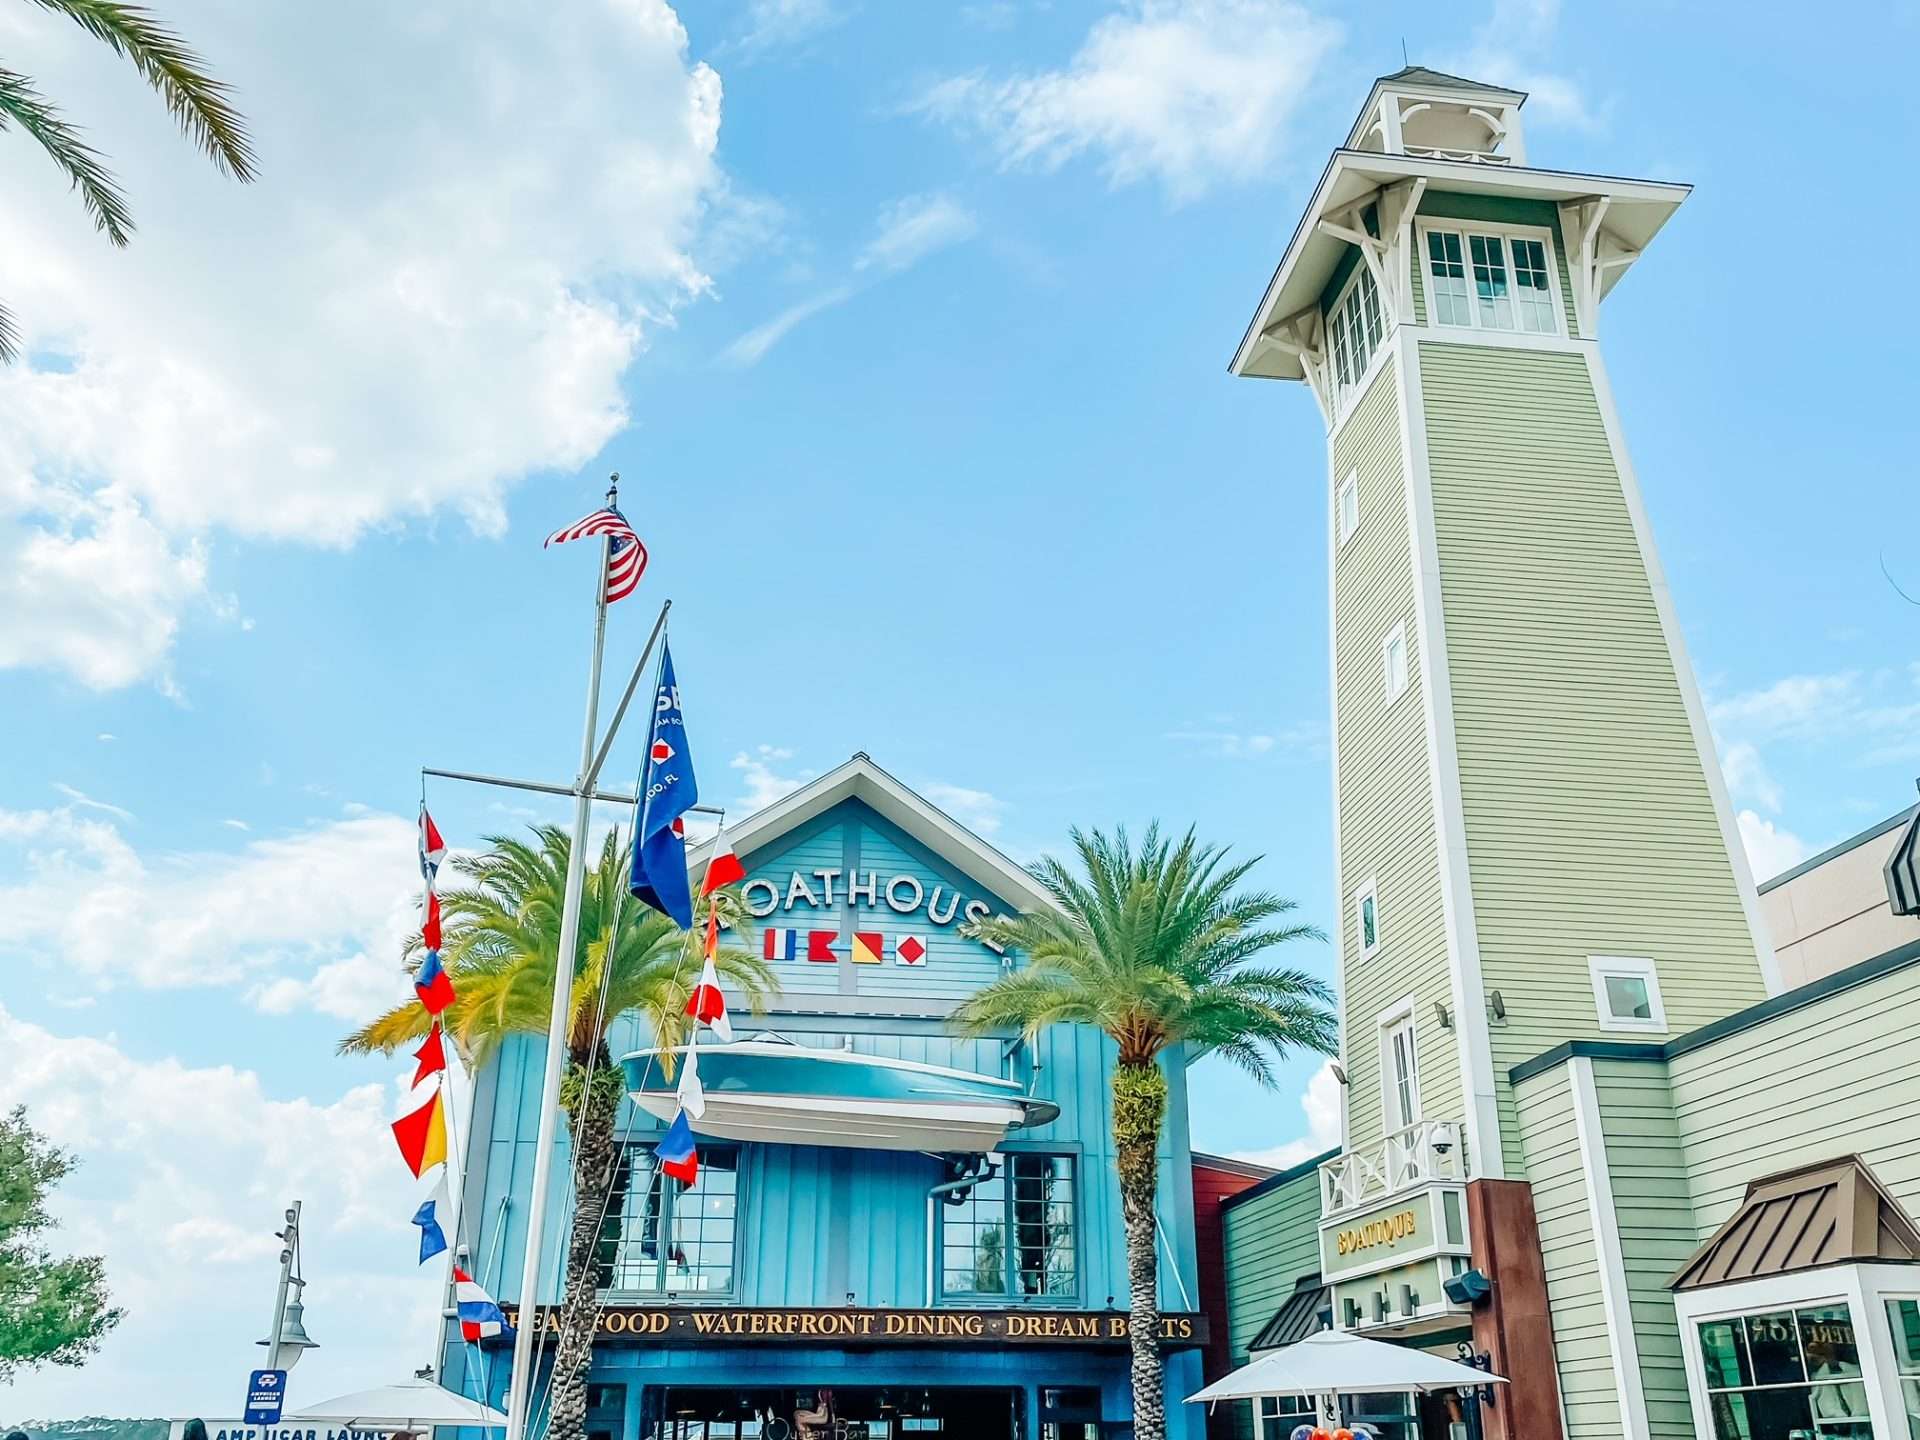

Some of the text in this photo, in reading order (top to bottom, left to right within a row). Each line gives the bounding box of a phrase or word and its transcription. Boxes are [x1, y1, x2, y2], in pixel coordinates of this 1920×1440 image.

[1337, 1209, 1416, 1256] BOATIQUE
[691, 1312, 876, 1336] WATERFRONT
[884, 1313, 984, 1337] DINING
[1006, 1316, 1100, 1338] DREAM
[1109, 1317, 1193, 1338] BTS
[835, 1417, 868, 1440] Bar
